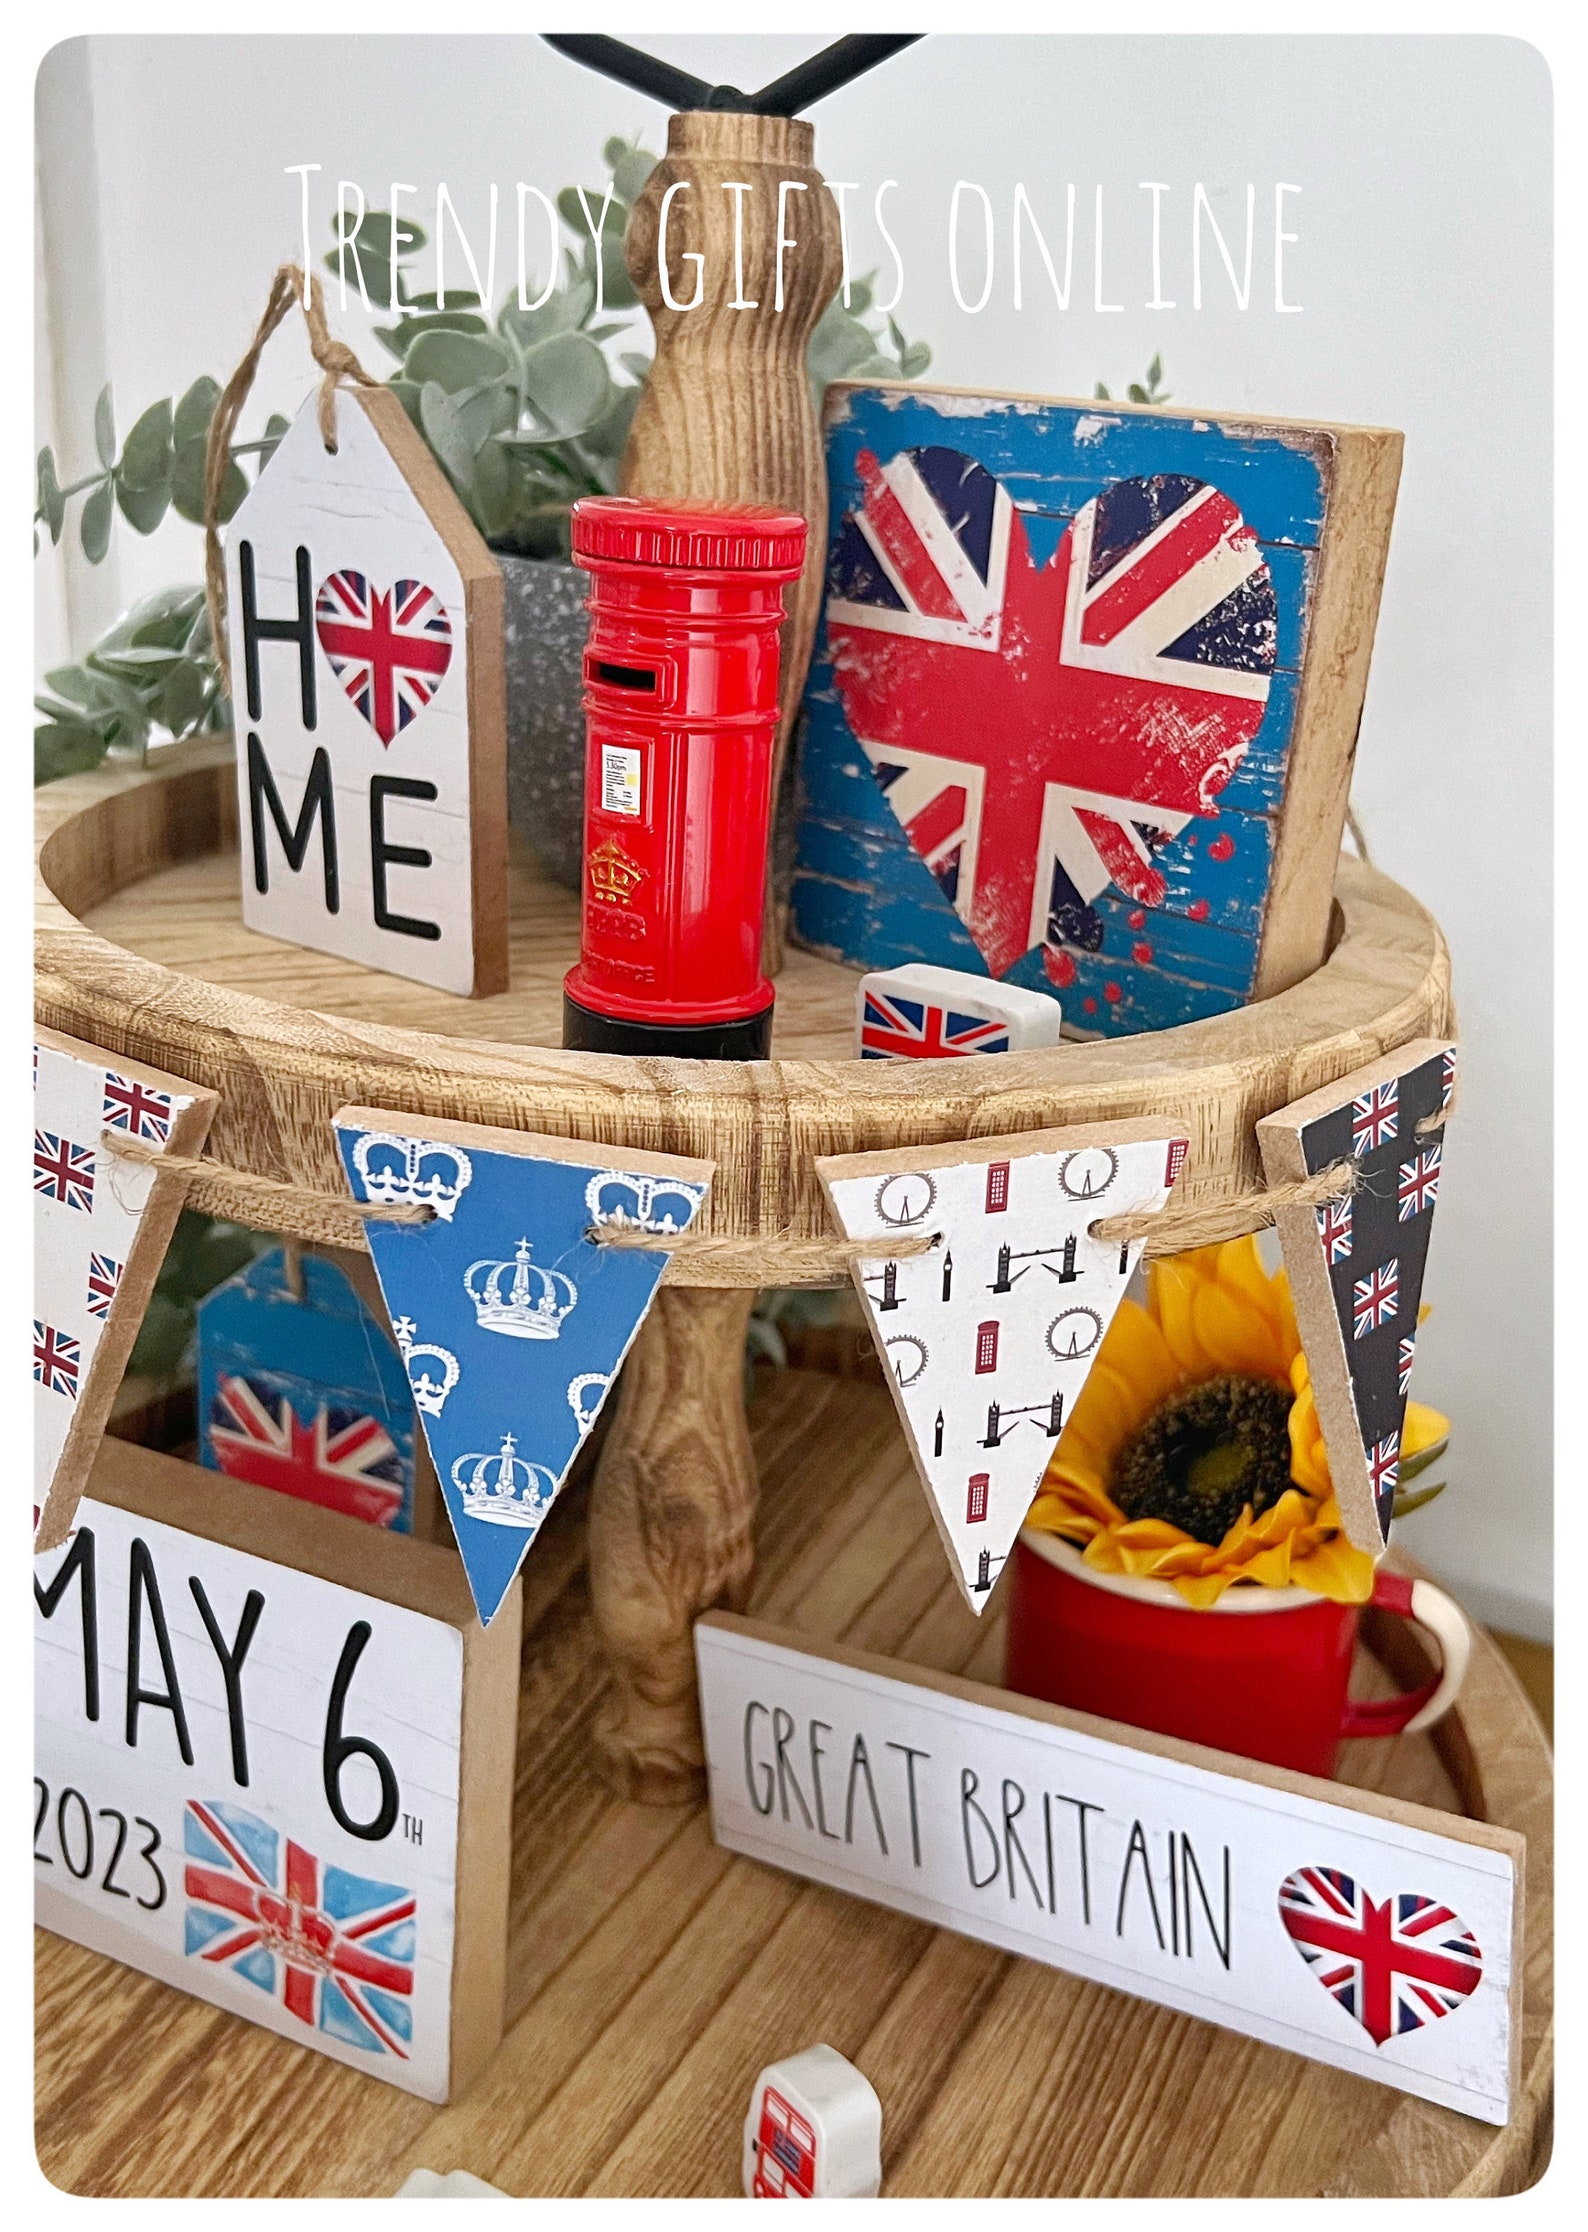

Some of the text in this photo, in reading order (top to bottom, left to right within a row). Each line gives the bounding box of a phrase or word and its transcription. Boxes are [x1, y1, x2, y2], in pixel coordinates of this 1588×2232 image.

[323, 1620, 400, 1841] 6
[402, 1813, 423, 1846] TH
[743, 1700, 1231, 1971] GREAT BRITAIN
